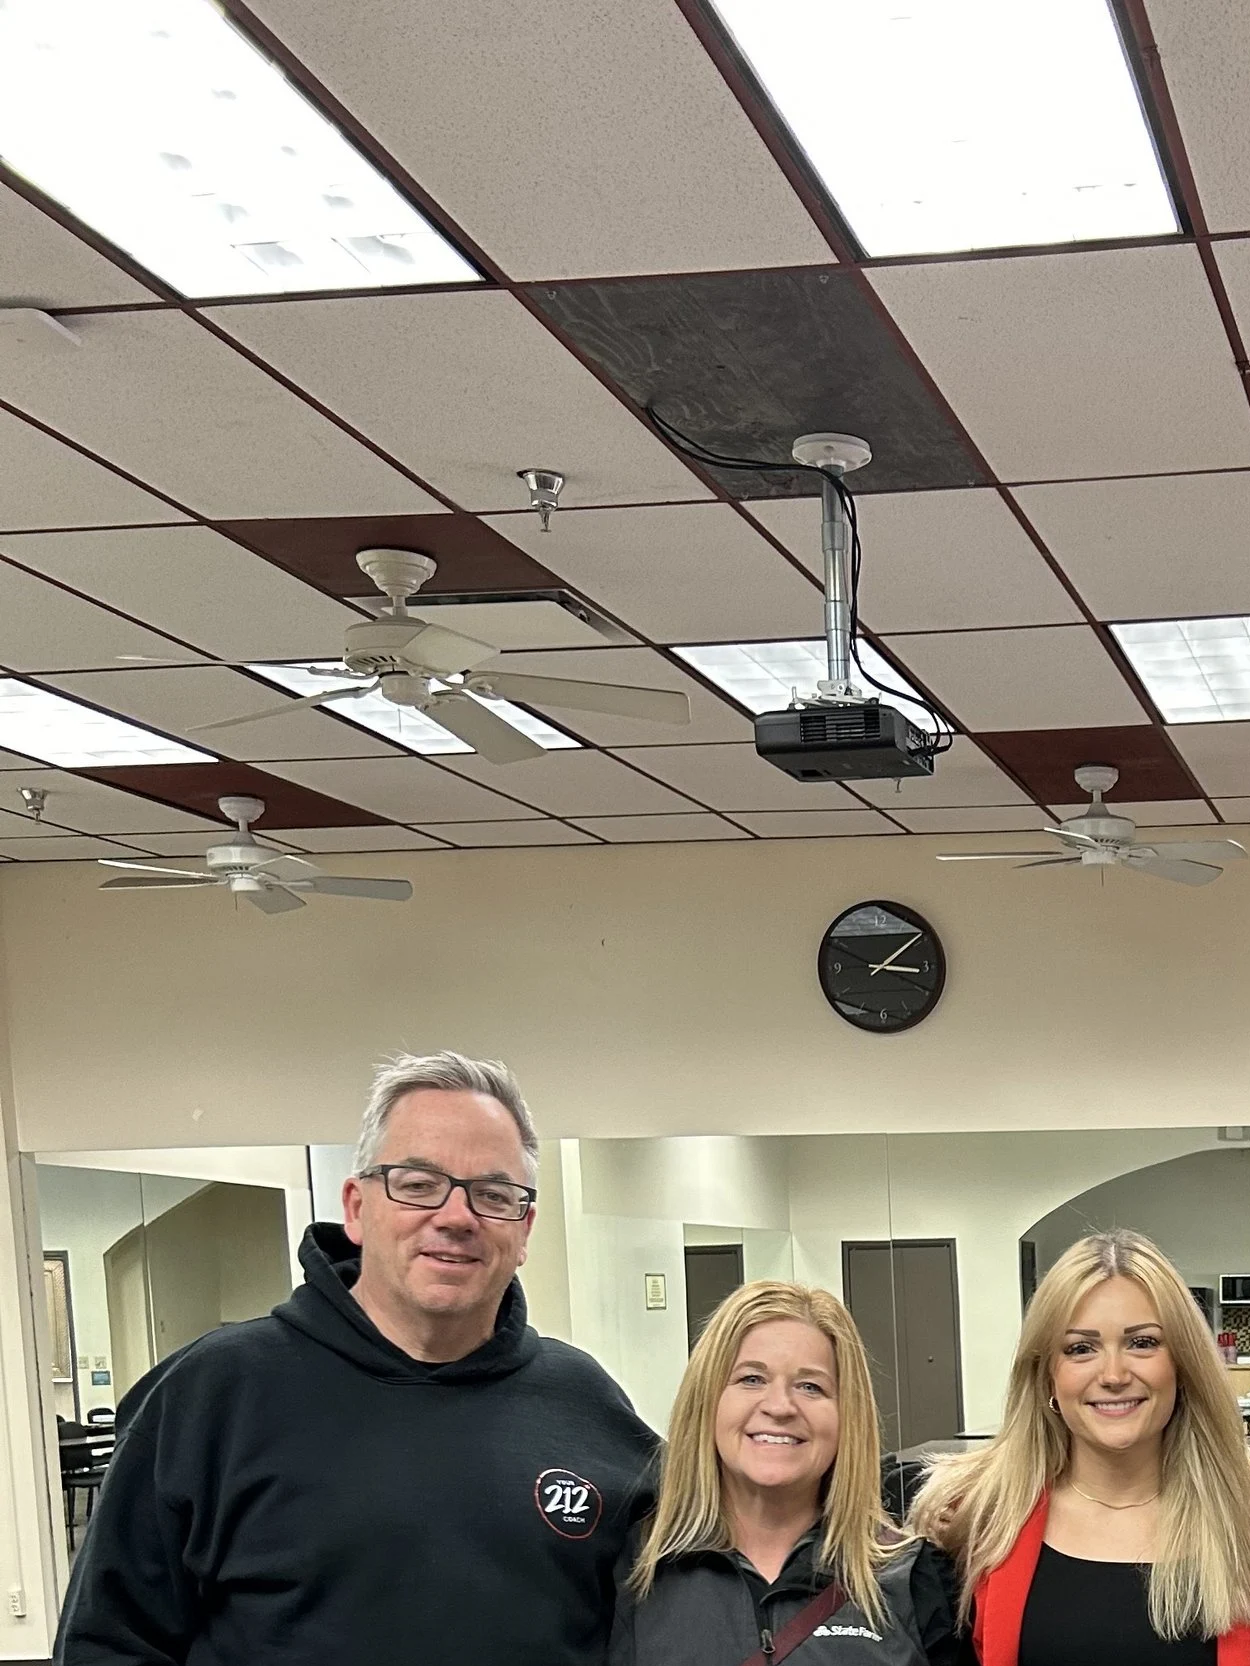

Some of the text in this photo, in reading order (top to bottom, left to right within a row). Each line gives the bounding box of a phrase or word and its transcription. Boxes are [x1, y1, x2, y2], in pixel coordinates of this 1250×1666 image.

[874, 915, 887, 928] 12
[834, 962, 842, 974] 9
[923, 960, 930, 973] 3
[879, 1007, 888, 1019] 6
[544, 1484, 590, 1514] 212
[563, 1515, 586, 1524] COACH
